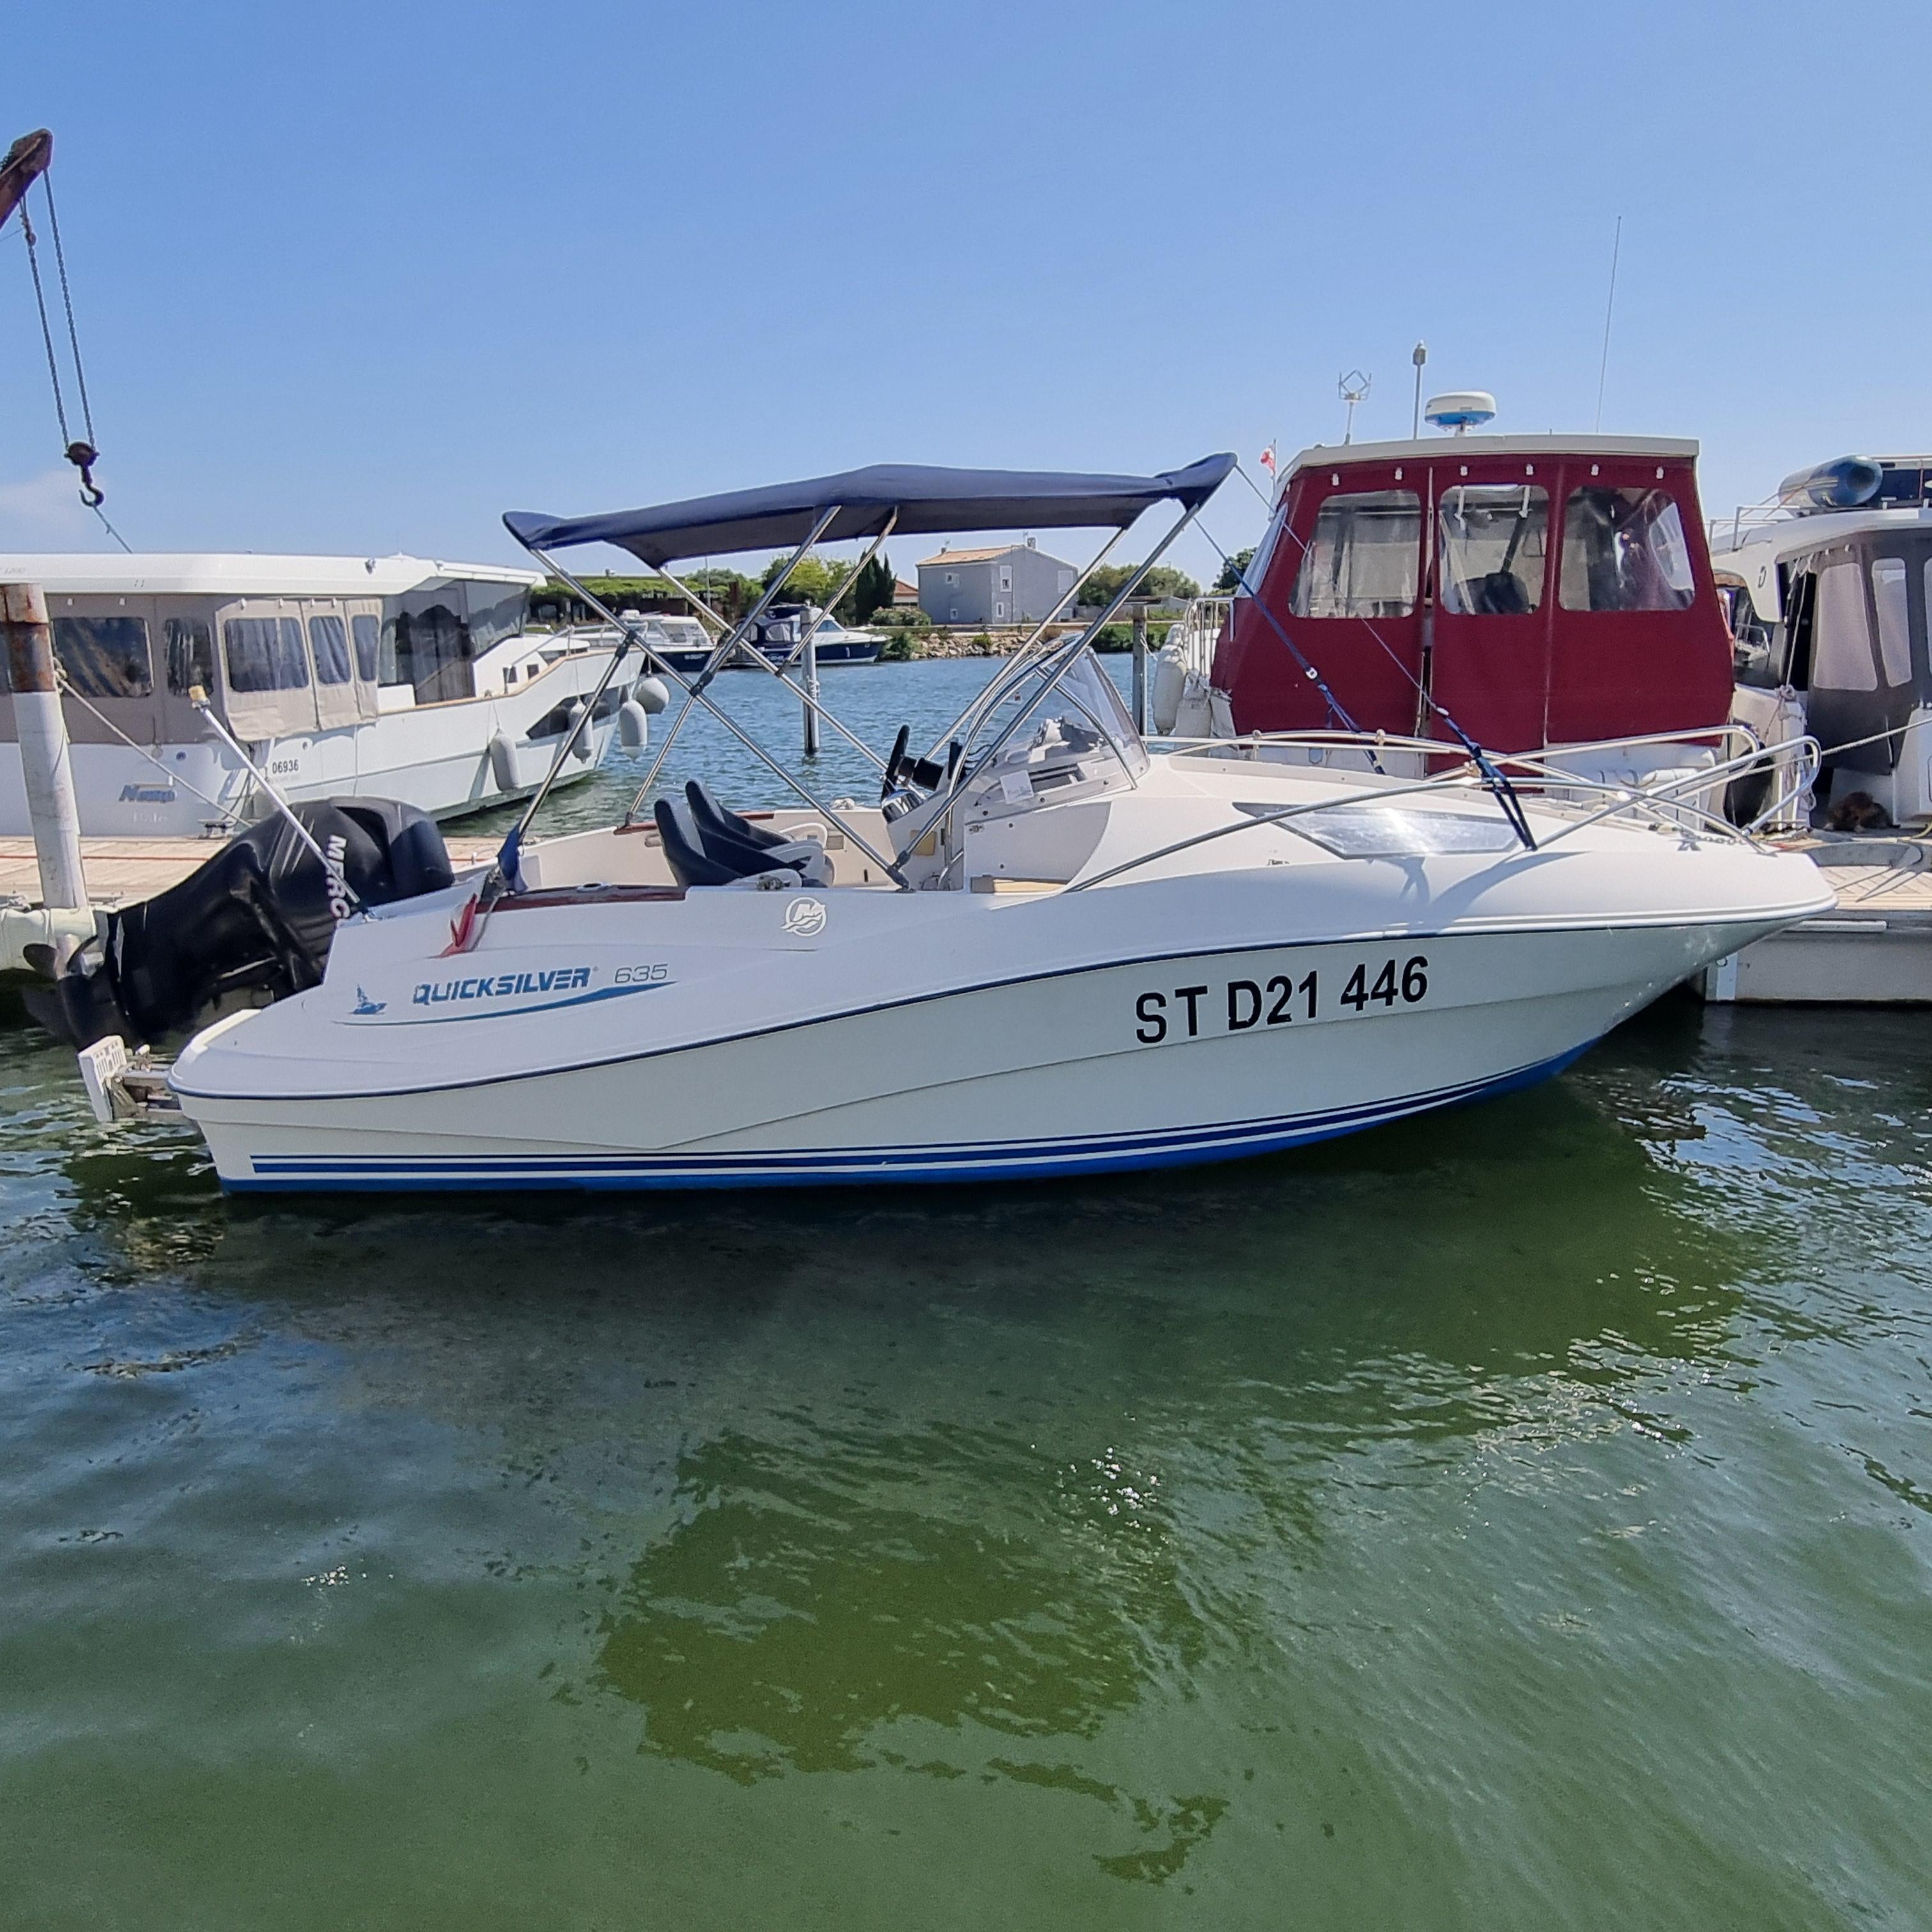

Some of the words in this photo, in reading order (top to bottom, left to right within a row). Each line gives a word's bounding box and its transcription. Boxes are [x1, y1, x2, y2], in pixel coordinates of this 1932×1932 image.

[272, 759, 298, 774] 06936
[413, 967, 590, 1005] QUICKSILVER
[615, 963, 668, 984] 635
[1136, 985, 1208, 1043] ST
[1228, 970, 1317, 1031] D21
[1340, 956, 1428, 1011] 446
